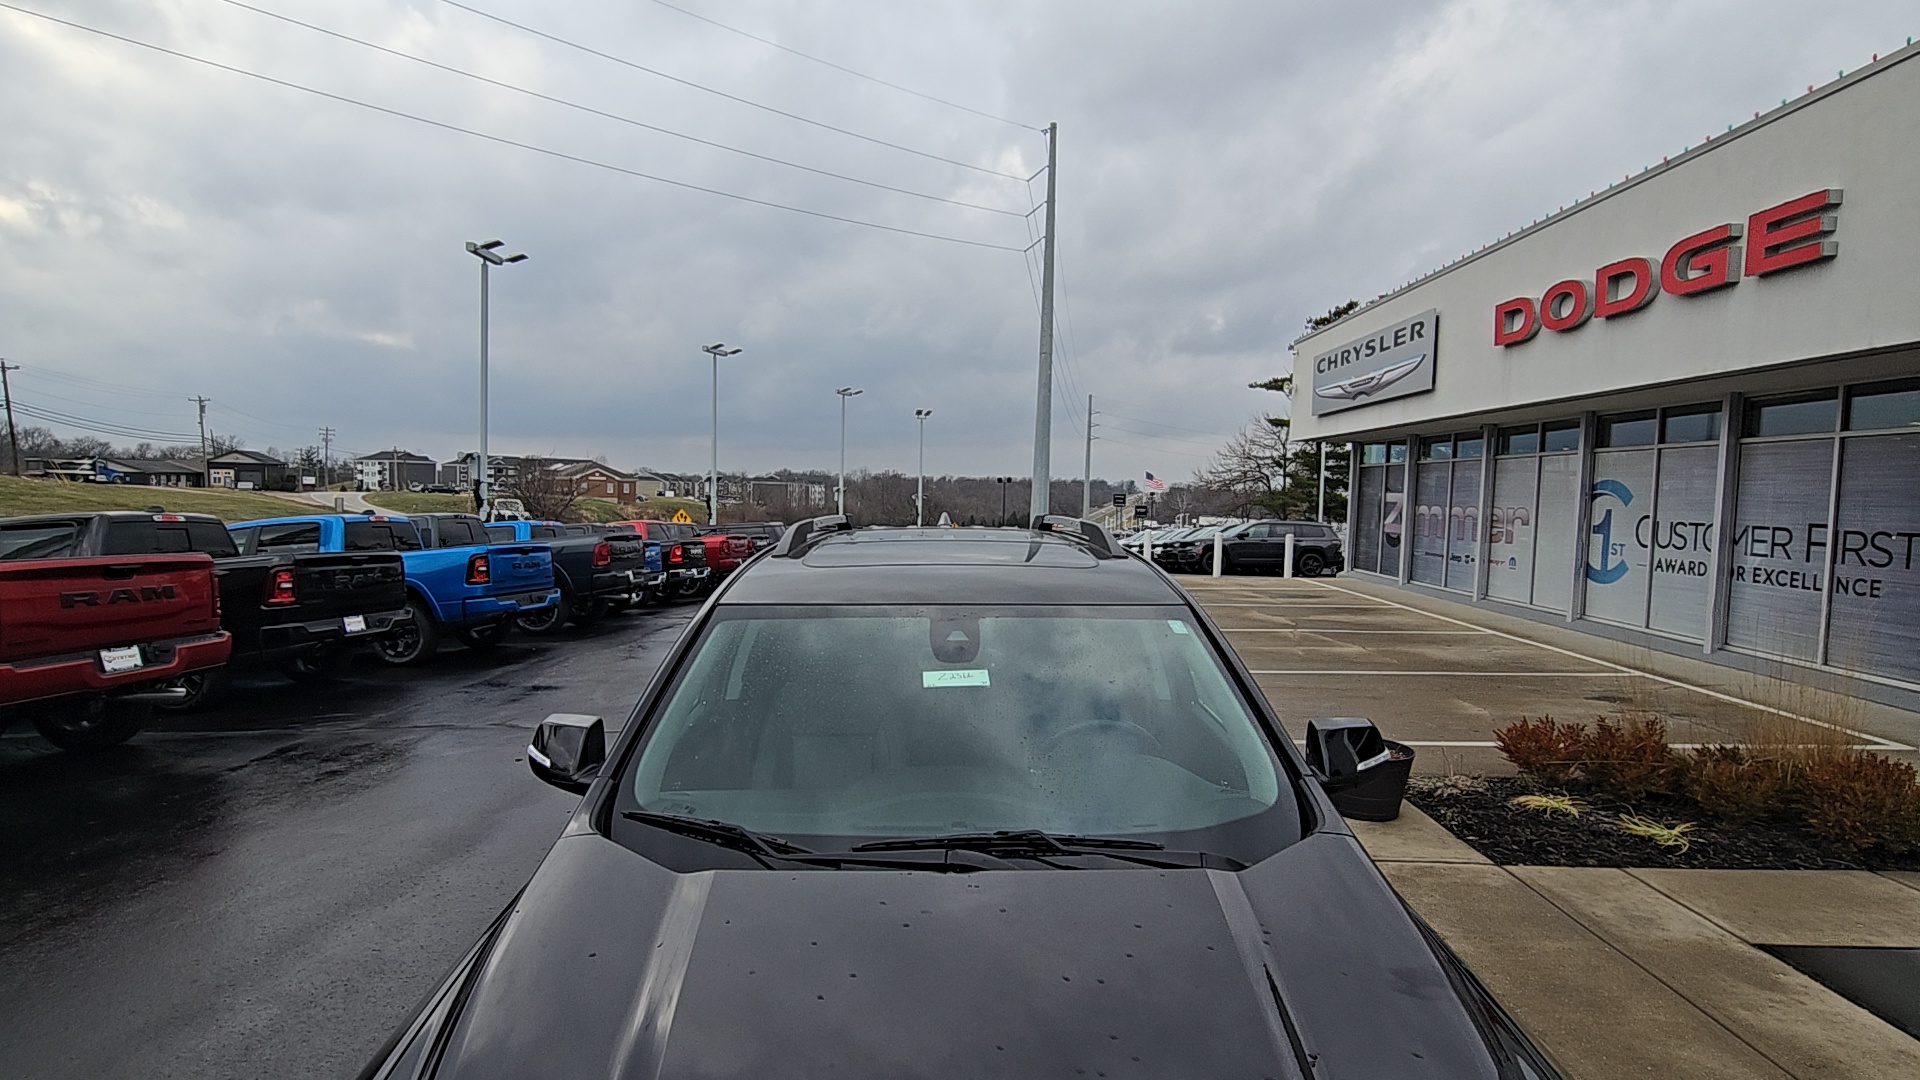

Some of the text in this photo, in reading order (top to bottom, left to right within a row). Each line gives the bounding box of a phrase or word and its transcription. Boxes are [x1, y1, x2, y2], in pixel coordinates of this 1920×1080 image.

[1494, 188, 1842, 347] DODGE
[1316, 320, 1426, 375] CHRYSLER
[1383, 492, 1530, 545] Zmmer
[512, 560, 541, 571] RAM
[1804, 522, 1920, 571] FIRST
[59, 584, 177, 609] RAM
[1654, 557, 1708, 578] AWARD
[1751, 566, 1882, 599] EXCELLNCE
